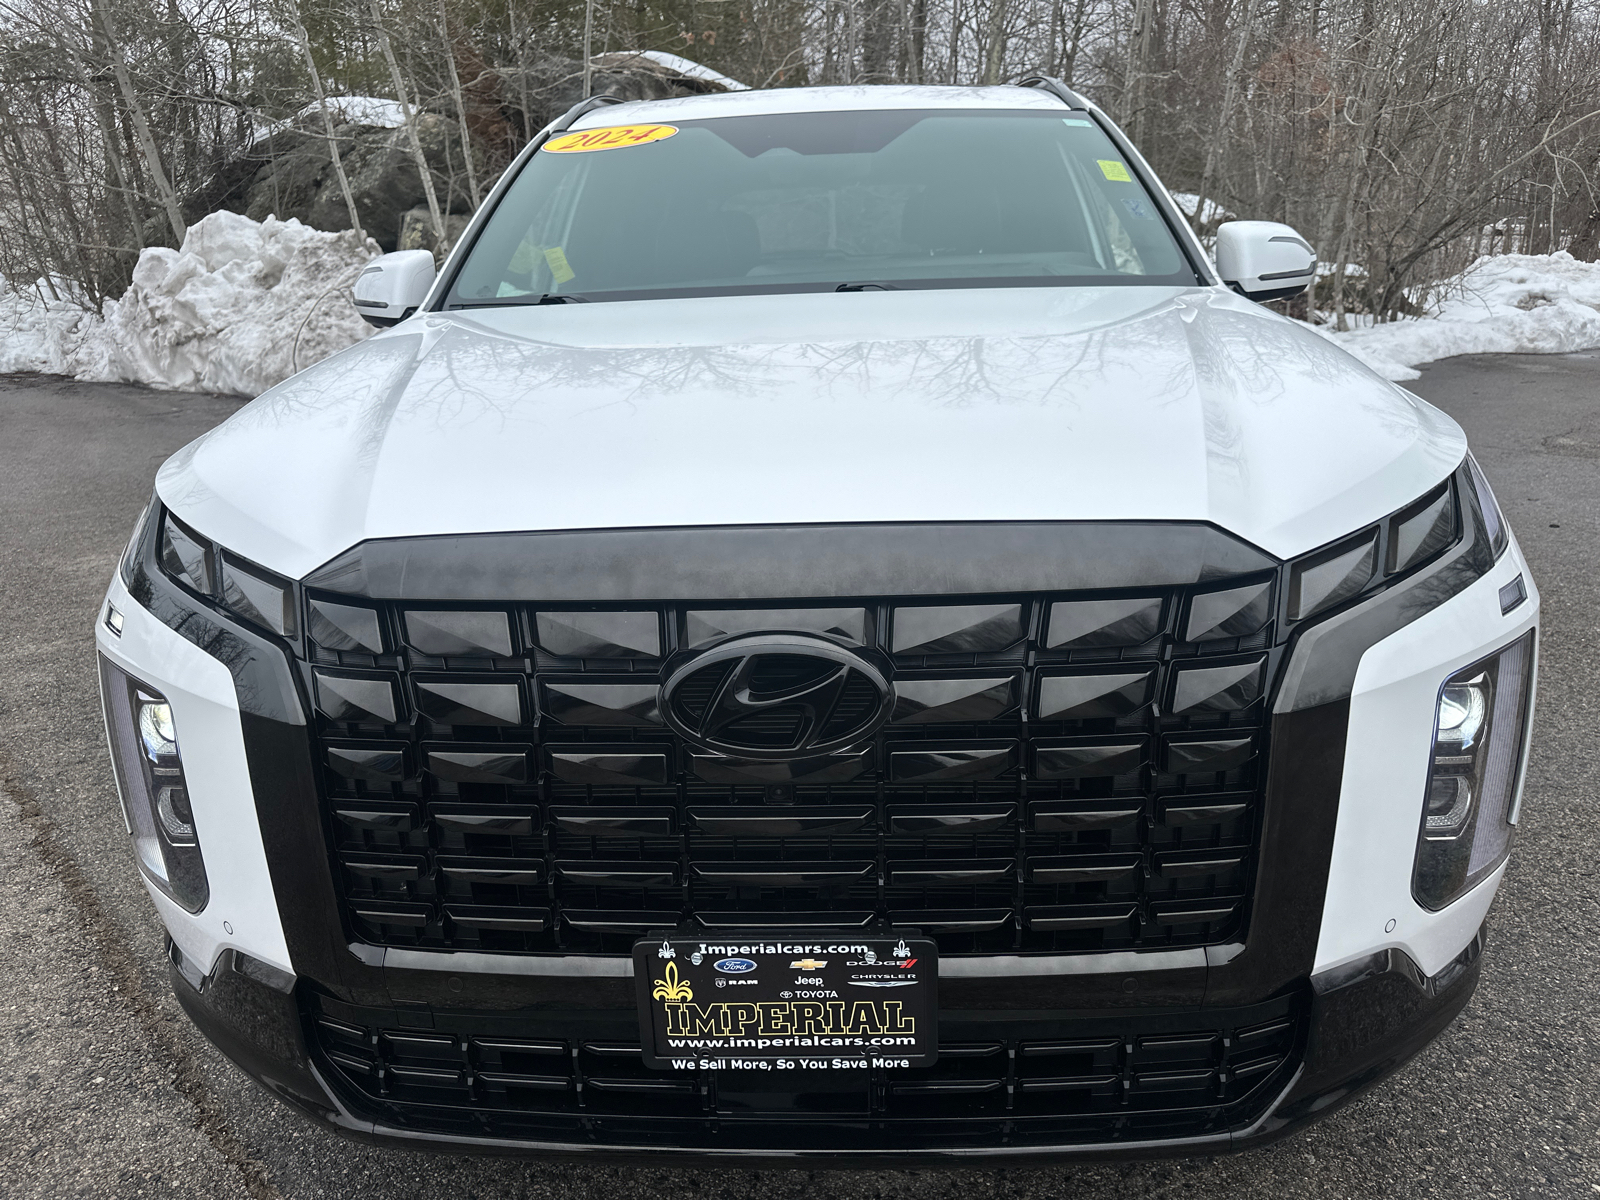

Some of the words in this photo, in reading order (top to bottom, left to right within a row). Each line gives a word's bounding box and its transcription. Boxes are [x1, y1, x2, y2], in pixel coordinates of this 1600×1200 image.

[556, 126, 663, 151] 2024
[699, 942, 869, 957] Imperialcars.com
[723, 960, 748, 971] Ford
[794, 975, 823, 987] Jeep
[794, 990, 839, 999] TOYOTA
[664, 1000, 916, 1037] IMPERIAL
[667, 1035, 917, 1050] www.imperialcars.com
[671, 1059, 697, 1070] We
[699, 1058, 727, 1070] Sell
[730, 1059, 773, 1072] More,
[776, 1058, 796, 1070] So
[799, 1058, 828, 1070] You
[831, 1058, 868, 1069] Save
[871, 1057, 910, 1069] More
